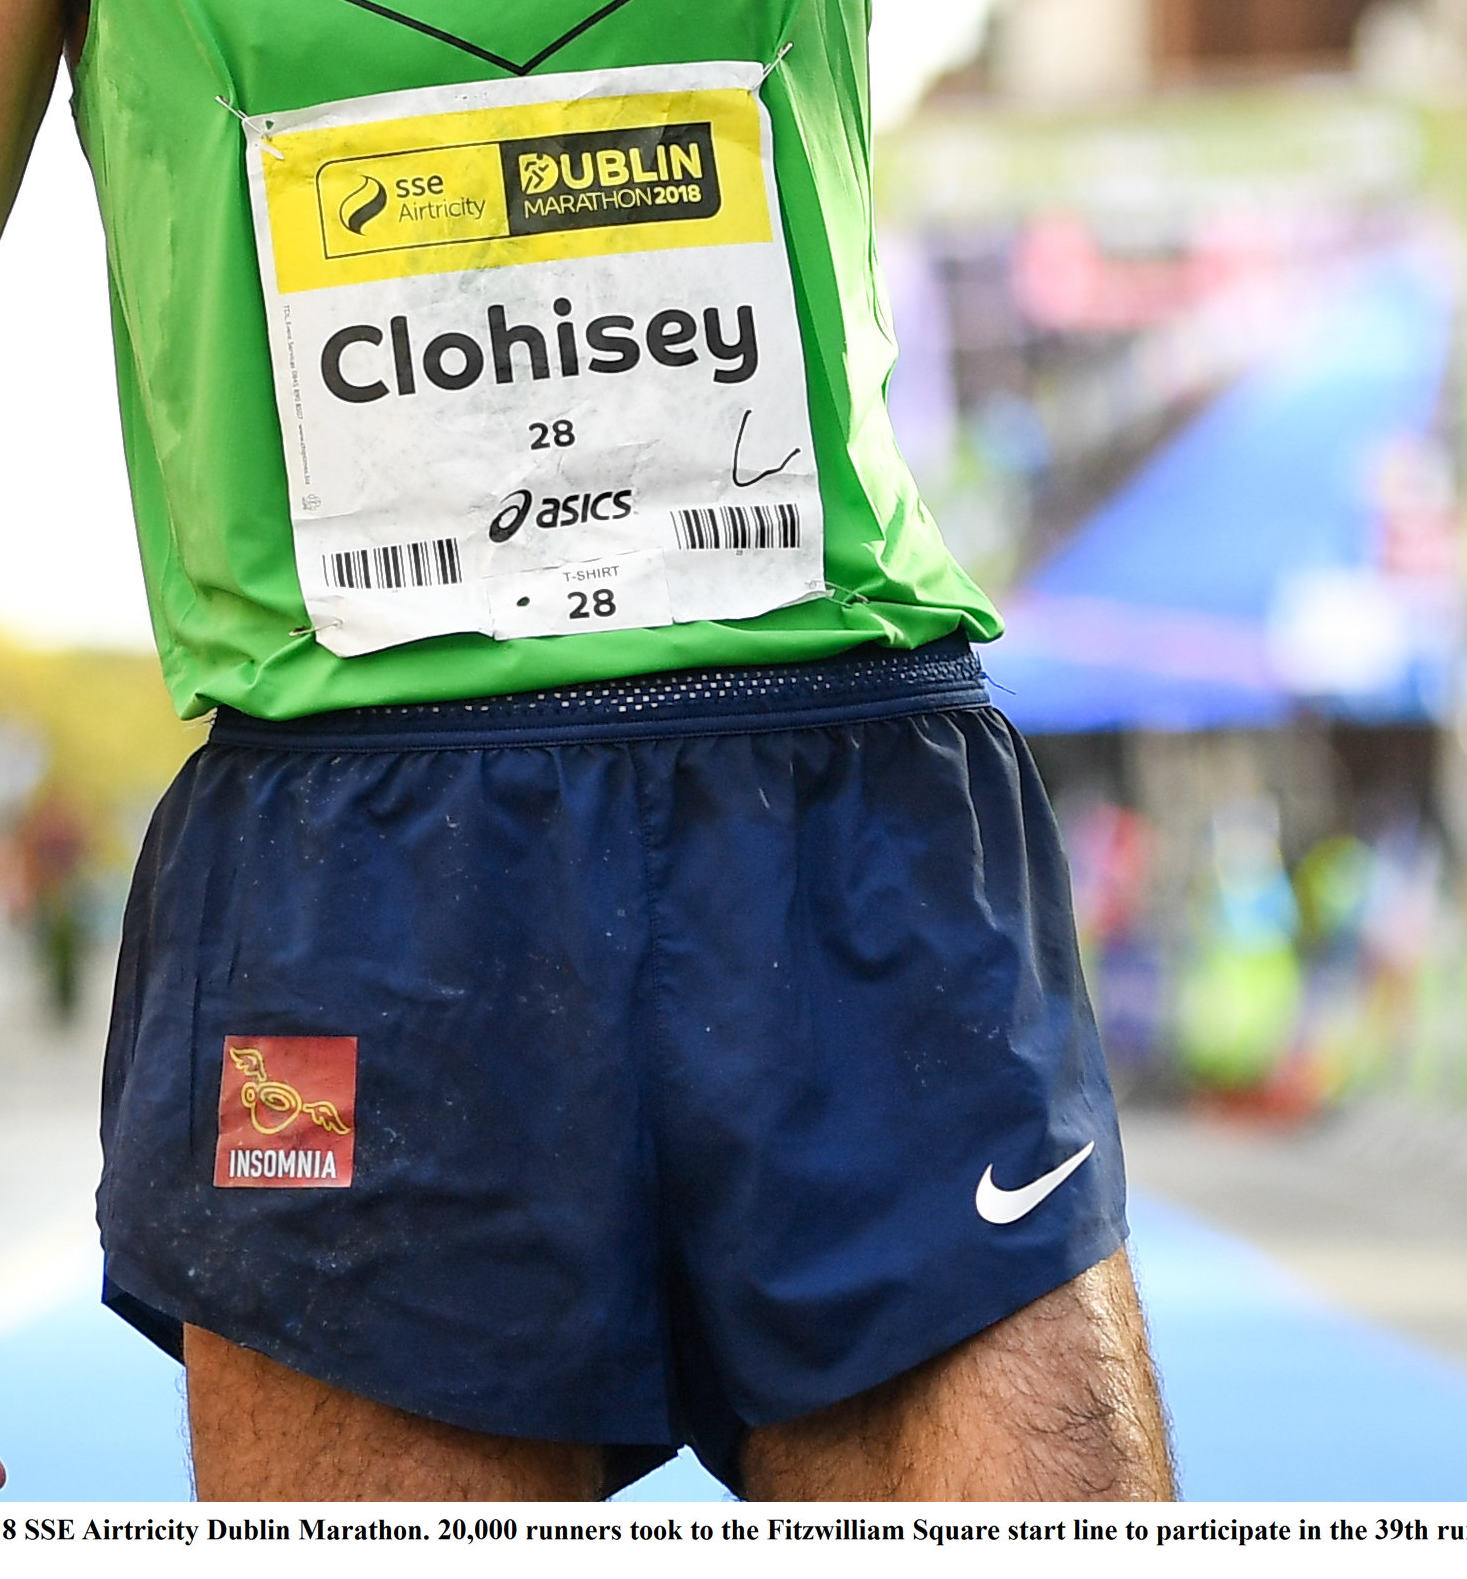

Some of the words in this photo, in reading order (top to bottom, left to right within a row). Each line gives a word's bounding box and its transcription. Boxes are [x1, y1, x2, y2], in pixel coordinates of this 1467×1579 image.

[518, 142, 704, 195] DUBLIN
[395, 173, 445, 198] sse
[398, 195, 487, 222] Airtricity
[320, 297, 759, 403] Clohisey
[528, 420, 575, 450] 28
[563, 565, 620, 583] T-SHIRT
[567, 588, 617, 620] 28
[228, 1148, 338, 1180] INSOMNIA
